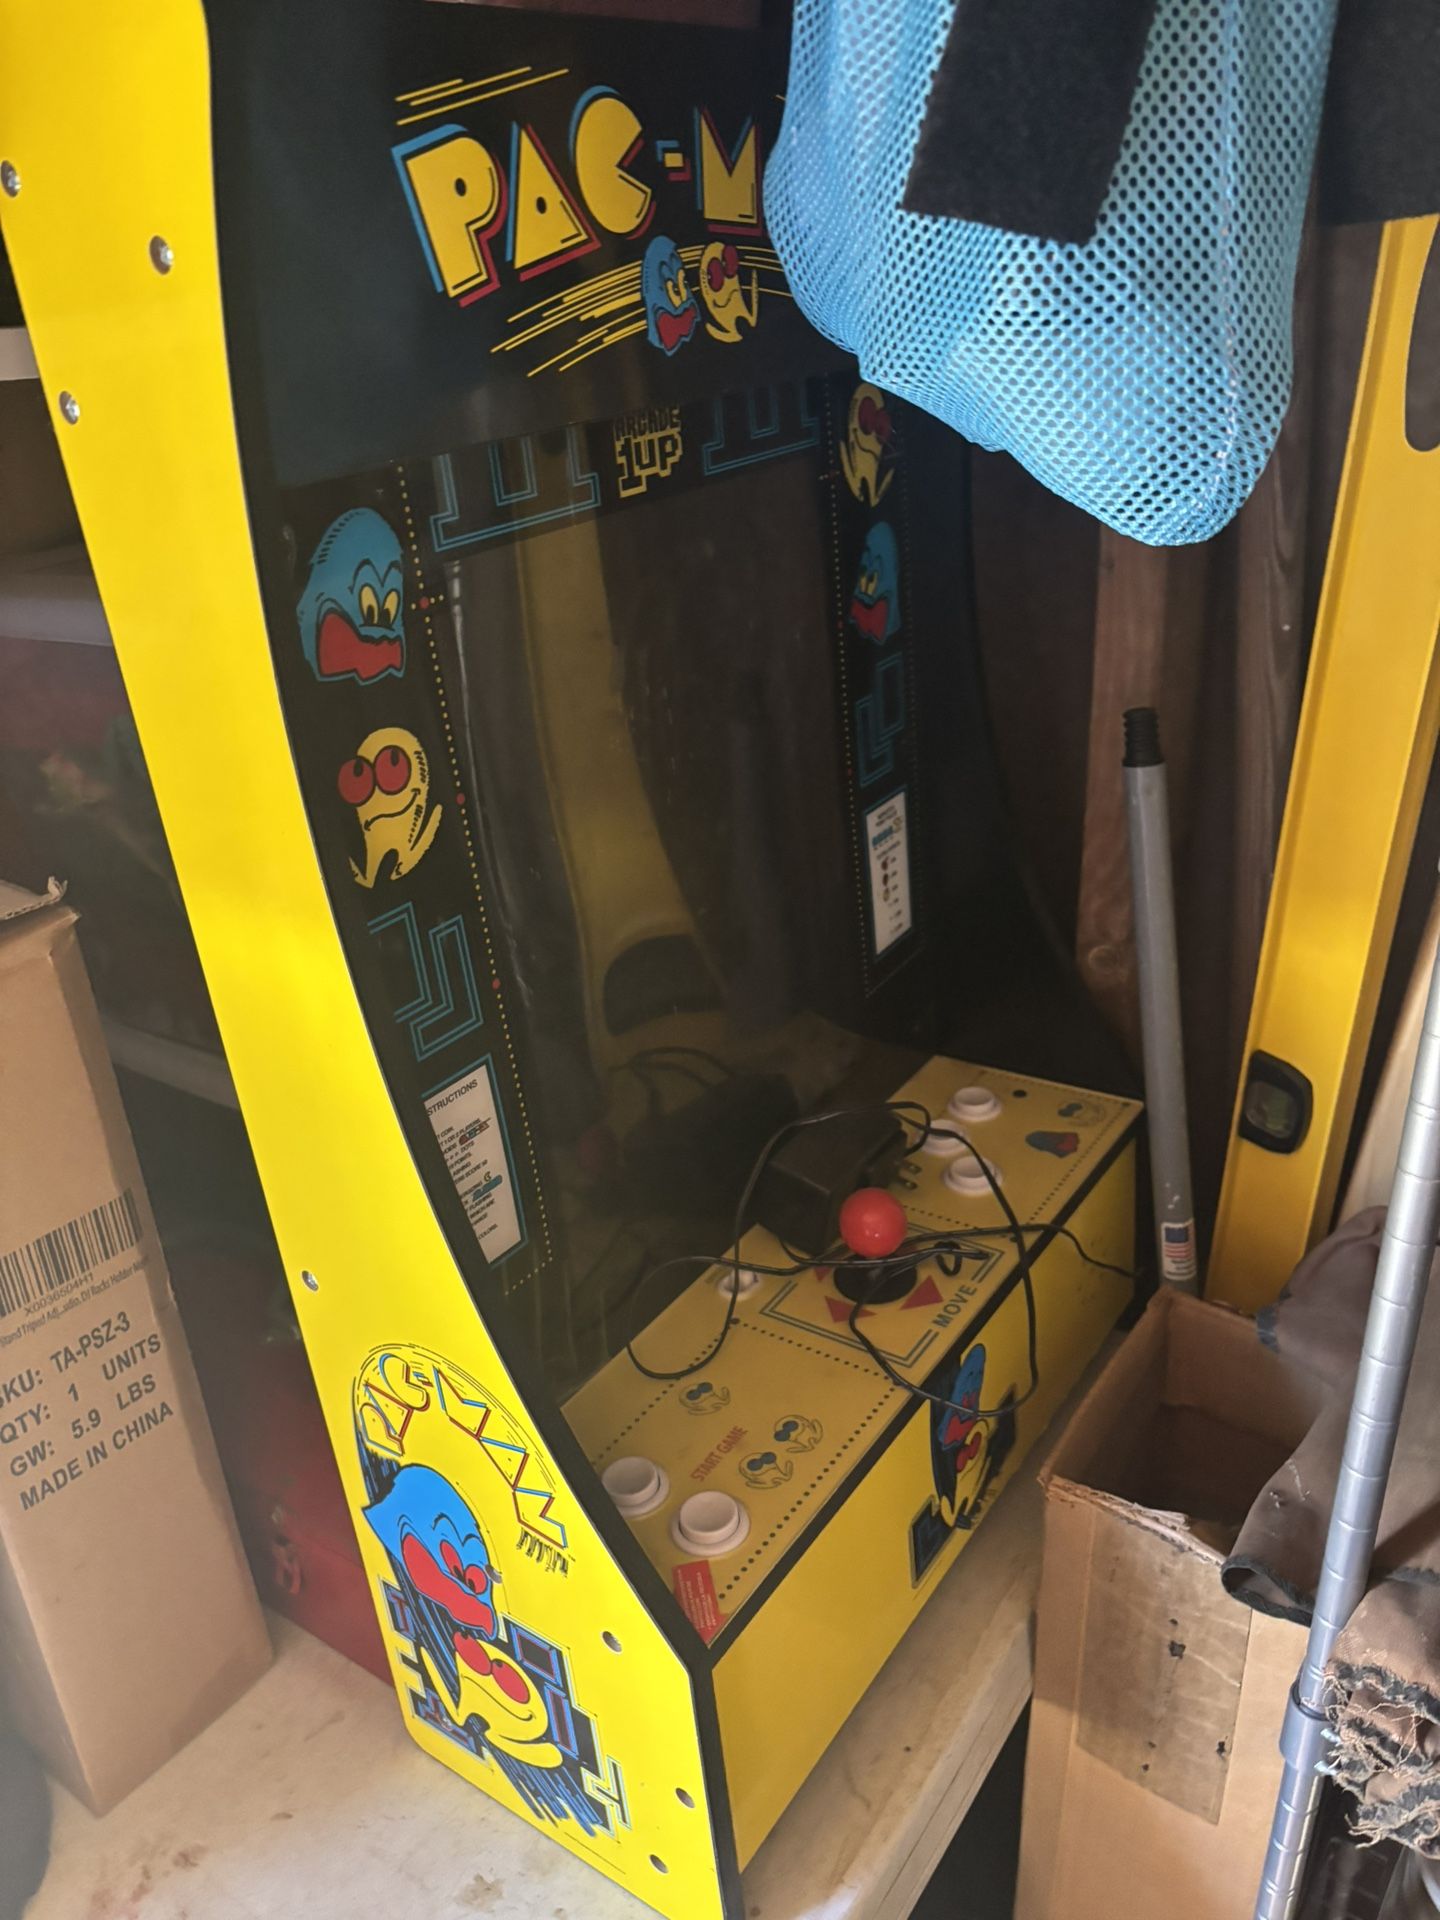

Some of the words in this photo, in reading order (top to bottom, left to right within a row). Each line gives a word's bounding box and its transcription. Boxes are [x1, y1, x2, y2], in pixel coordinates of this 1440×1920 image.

[613, 407, 682, 442] ARCADE
[615, 428, 683, 498] 1UP
[932, 1284, 978, 1329] MOVE
[0, 1368, 43, 1409] KU:
[50, 1311, 131, 1374] TA-PSZ-3
[0, 1403, 51, 1445] QTY:
[67, 1382, 80, 1402] 1
[101, 1333, 162, 1382] UNITS
[10, 1439, 56, 1478] GW:
[71, 1408, 102, 1440] 5.9
[115, 1373, 157, 1411] LBS
[19, 1457, 84, 1511] MADE
[85, 1440, 109, 1469] IN
[111, 1401, 174, 1451] CHINA
[359, 1352, 569, 1552] PAC-MAN
[690, 1451, 723, 1483] START
[716, 1425, 749, 1455] GAME
